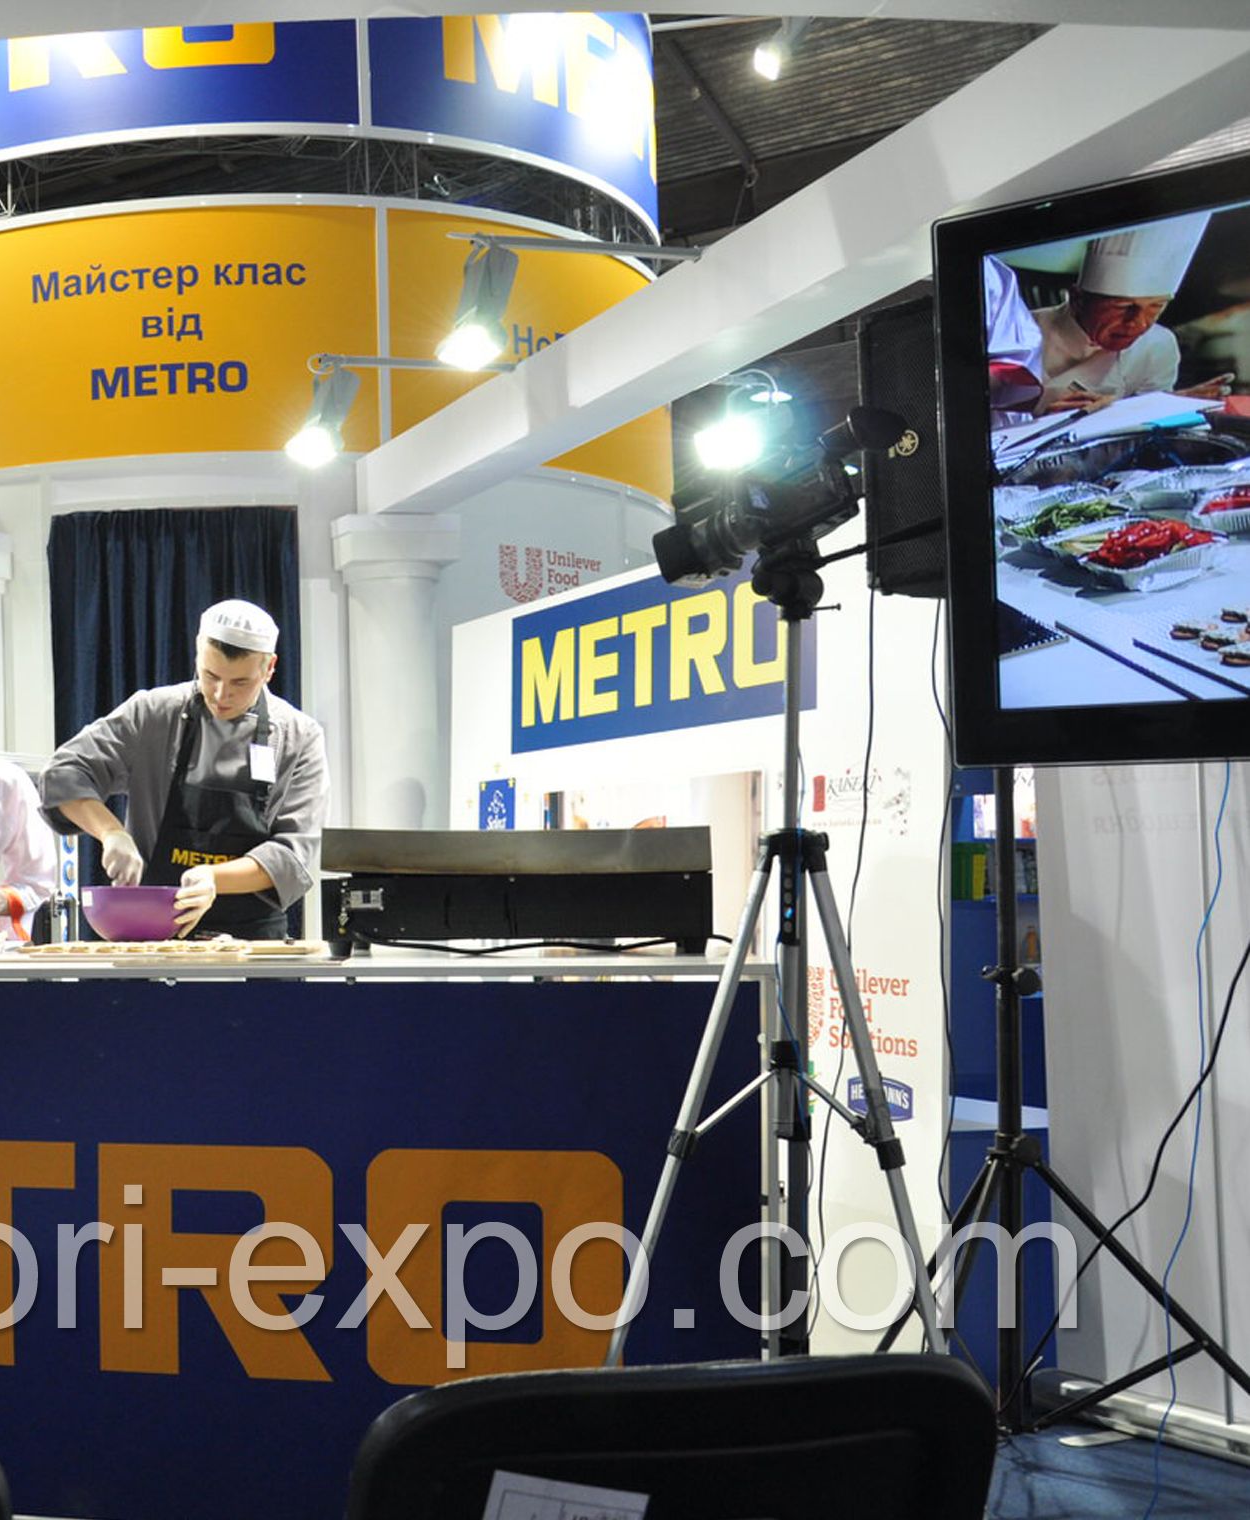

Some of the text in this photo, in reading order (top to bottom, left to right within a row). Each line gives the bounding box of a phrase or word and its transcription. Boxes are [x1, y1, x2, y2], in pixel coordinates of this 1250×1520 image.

[31, 261, 307, 304] Майстер клас
[141, 306, 204, 342] від
[90, 360, 249, 401] METRO
[546, 549, 602, 573] Unilever
[546, 568, 580, 587] Food
[521, 580, 787, 728] METRO
[171, 848, 241, 867] METR
[830, 968, 910, 997] Uilever
[830, 997, 873, 1023] Fod
[829, 1025, 918, 1058] Soions
